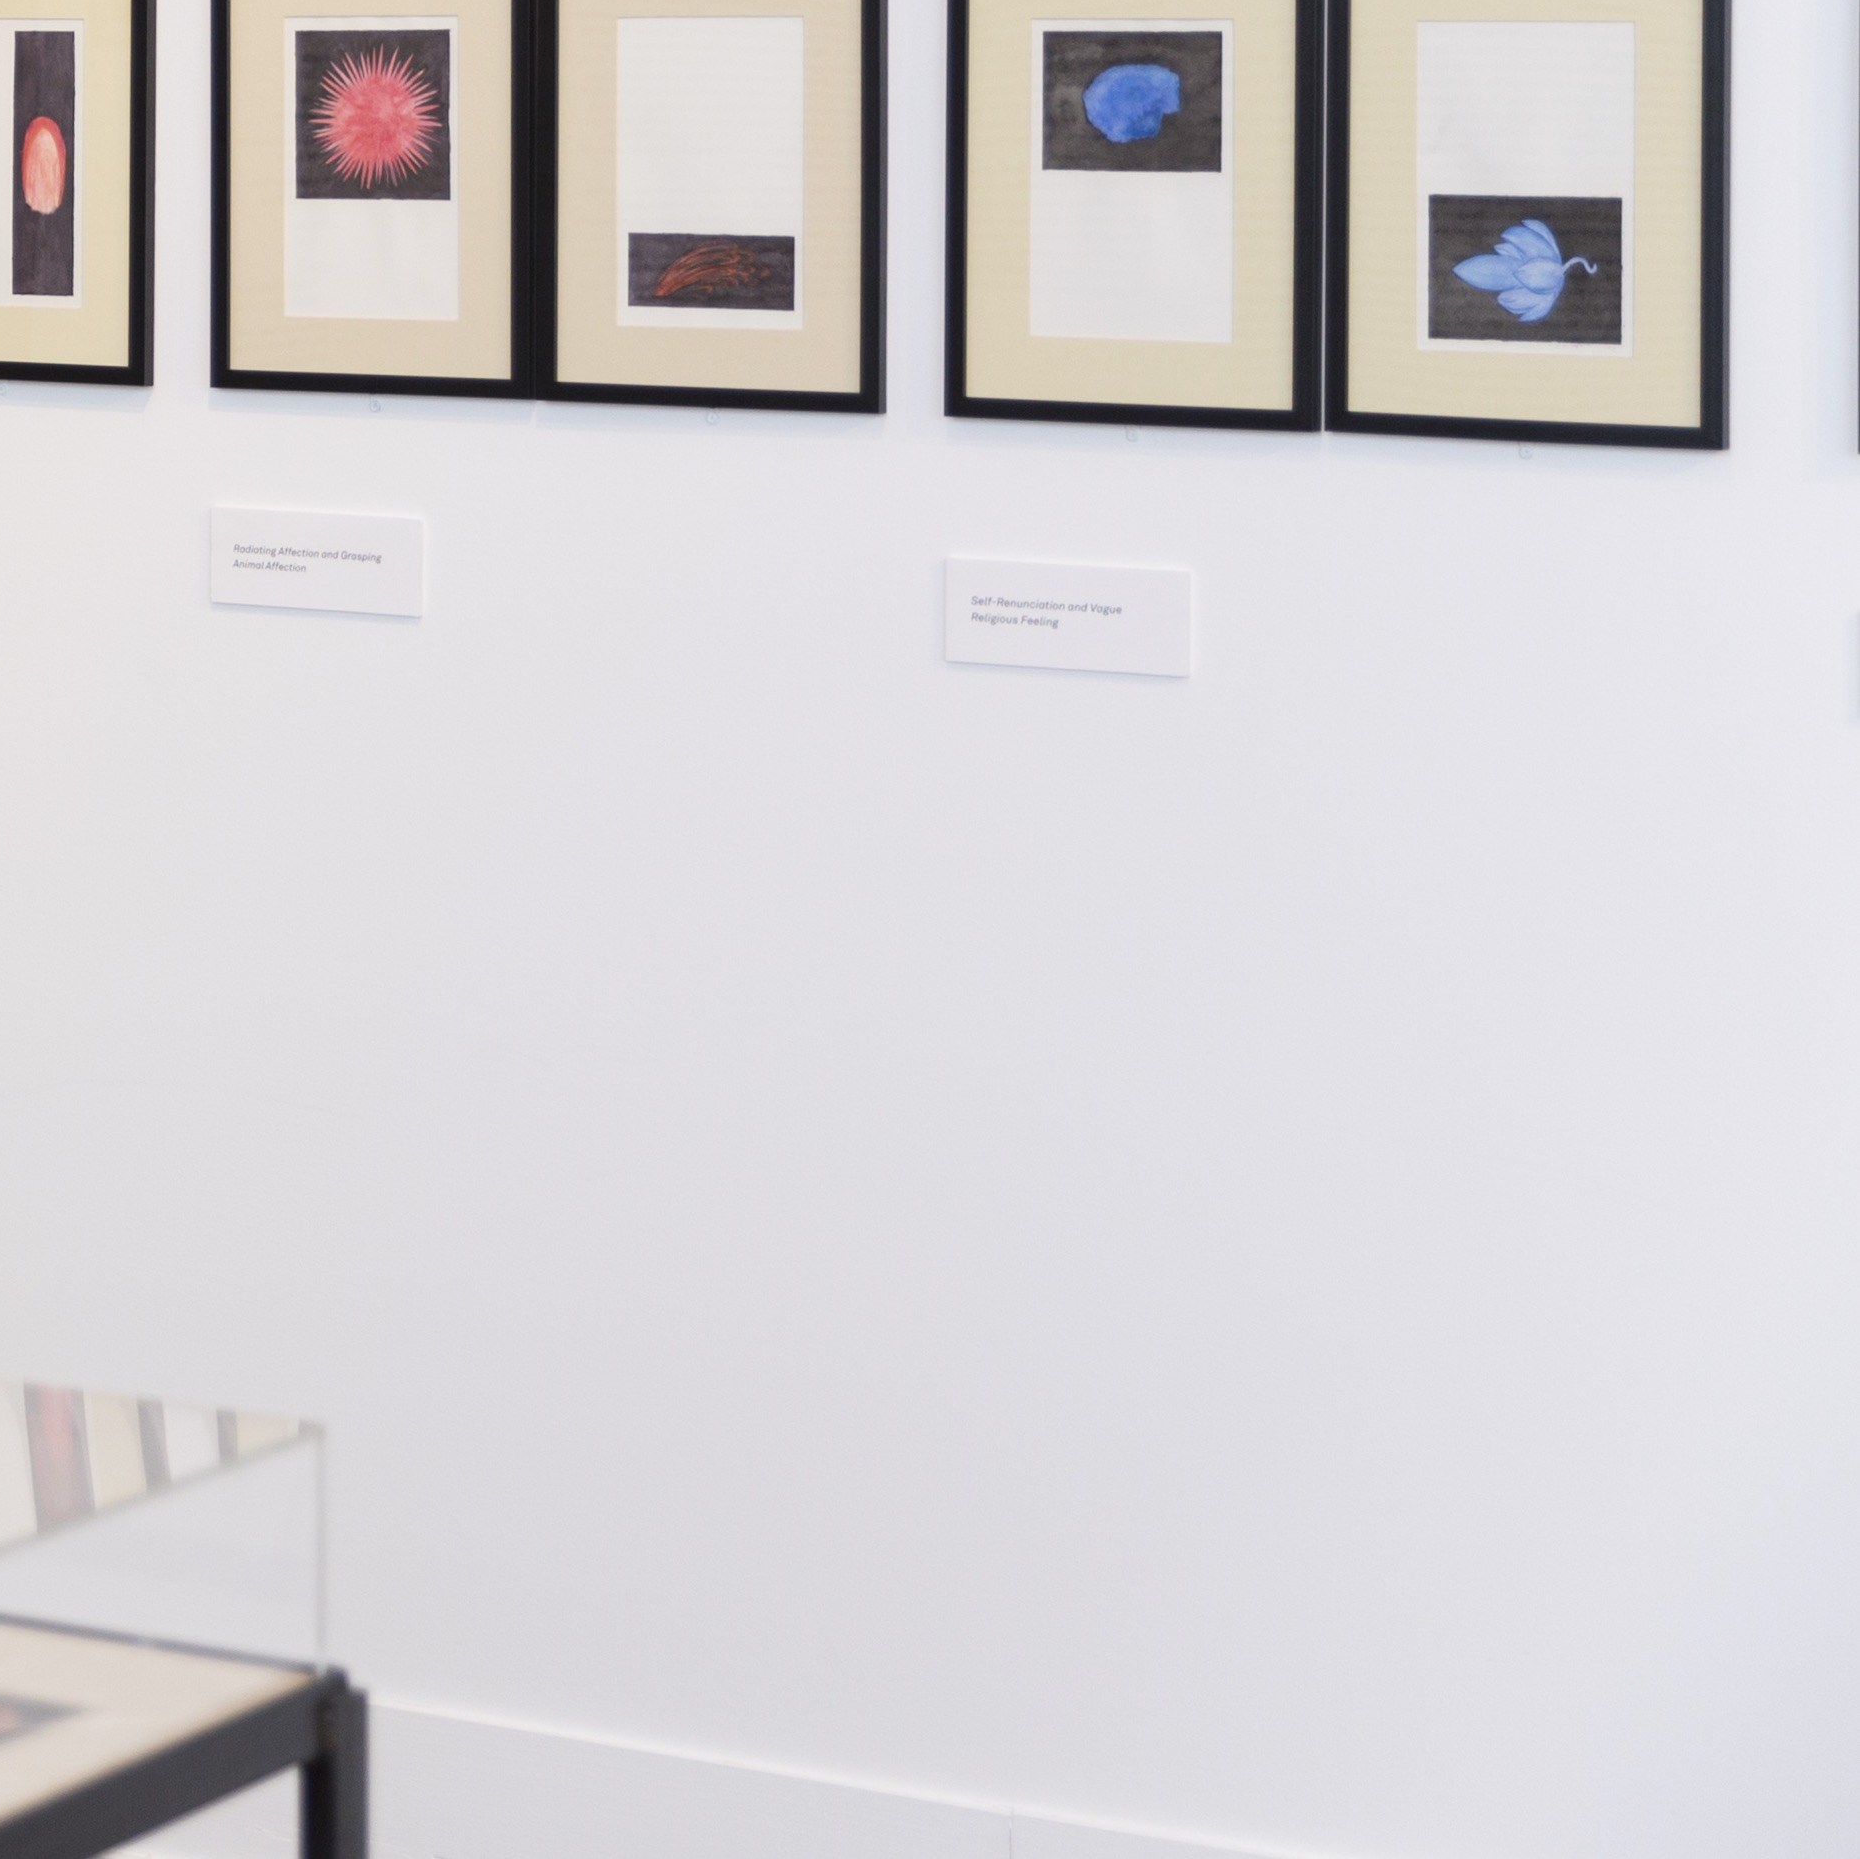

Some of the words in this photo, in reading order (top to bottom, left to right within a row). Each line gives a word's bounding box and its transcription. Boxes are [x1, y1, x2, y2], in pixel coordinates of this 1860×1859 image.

[233, 544, 277, 557] Radiating
[278, 546, 319, 558] Affection
[321, 550, 339, 560] and
[341, 551, 382, 564] Grasping
[233, 559, 264, 570] Animal
[265, 561, 307, 572] Affection
[971, 595, 1065, 611] Self-Renunciation
[1068, 602, 1087, 613] and
[1090, 603, 1122, 616] Vague
[971, 612, 1018, 625] Religious
[1021, 615, 1059, 629] Feeling
